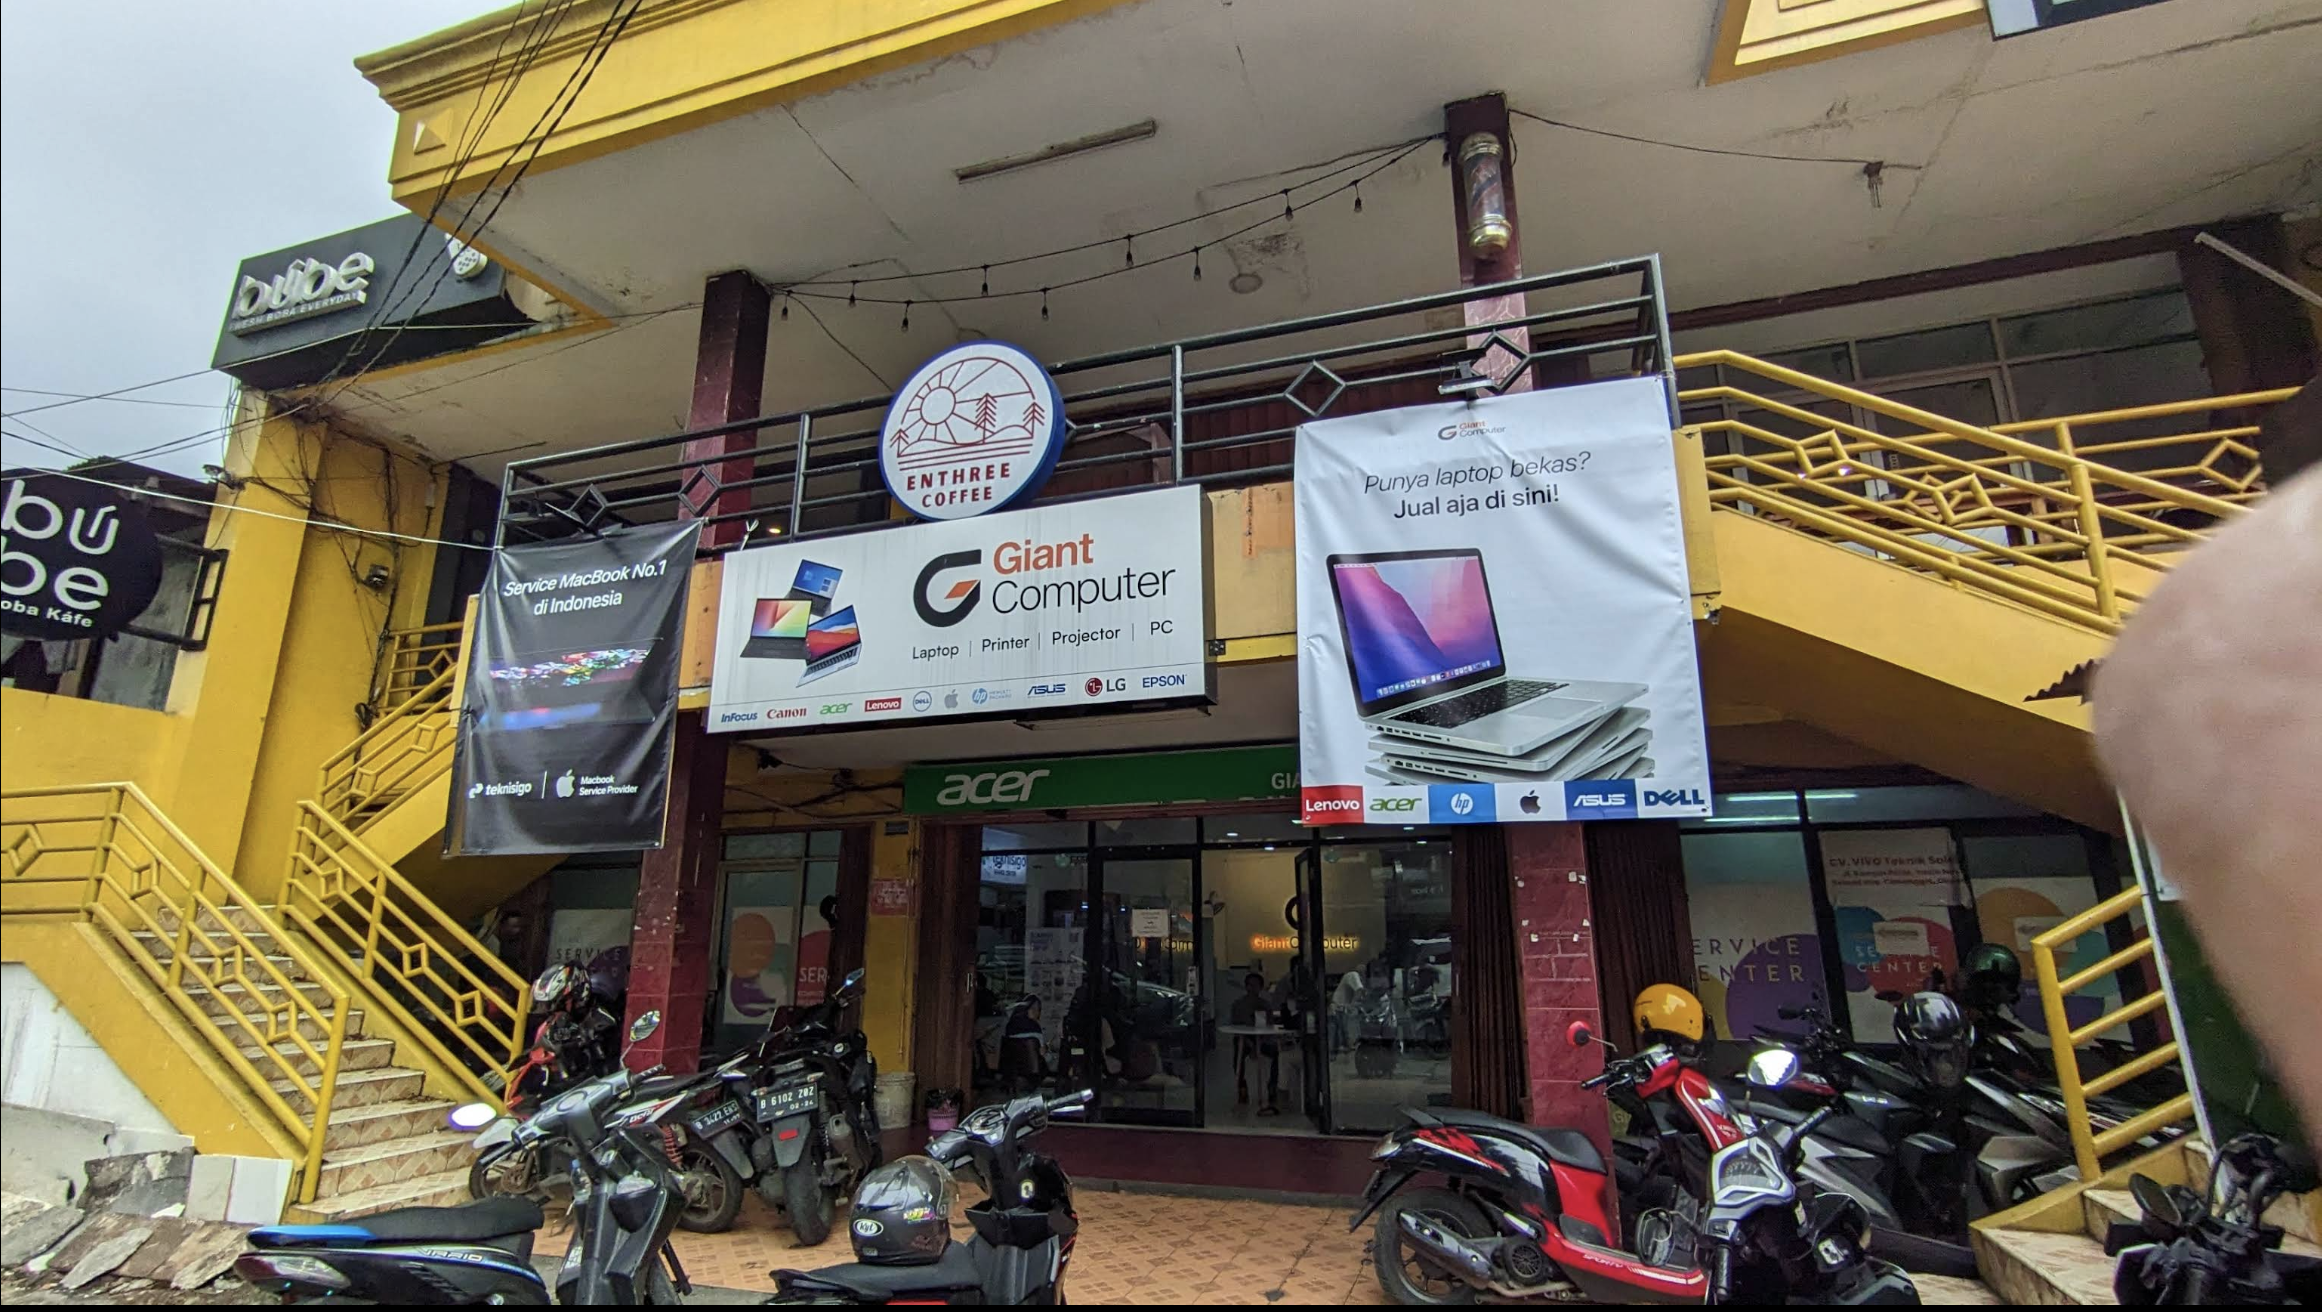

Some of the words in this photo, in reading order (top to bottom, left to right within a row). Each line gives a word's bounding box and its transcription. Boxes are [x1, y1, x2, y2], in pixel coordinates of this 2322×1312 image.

[1459, 420, 1486, 430] Giant
[1460, 426, 1506, 438] Computer
[907, 462, 1011, 491] ENTHREE
[1363, 474, 1429, 495] Punya
[1436, 463, 1503, 487] laptop
[1509, 451, 1591, 478] bekas?
[922, 486, 993, 508] COFFEE
[1394, 496, 1441, 519] Jual
[1446, 494, 1480, 517] aja
[1485, 489, 1506, 510] di
[1512, 483, 1560, 506] sini!
[993, 533, 1095, 575] Giant
[503, 577, 557, 597] Service
[558, 565, 631, 589] MacBook
[631, 559, 668, 580] No.1
[992, 567, 1177, 615] Computer
[533, 598, 548, 616] di
[549, 590, 623, 614] Indonesia
[912, 643, 960, 661] Laptop
[981, 636, 1030, 653] Printer
[1052, 626, 1121, 647] Projector
[1150, 620, 1174, 636] PC
[721, 711, 758, 723] InFocus
[766, 707, 807, 720] Canon
[819, 702, 853, 715] acer
[866, 699, 900, 711] Lenovo
[1027, 683, 1066, 696] ASUS
[1106, 678, 1127, 692] LG
[1142, 674, 1186, 688] EPSON
[485, 781, 532, 796] teknisigo
[579, 786, 606, 797] Service
[607, 784, 639, 795] Provider
[580, 775, 615, 785] Macbook
[936, 769, 1050, 806] acer
[1306, 797, 1360, 813] Lenovo
[1369, 797, 1423, 813] acer
[1453, 792, 1470, 815] hp
[1573, 793, 1627, 808] ASUS
[1644, 788, 1705, 807] DELL
[771, 1091, 793, 1106] 6102
